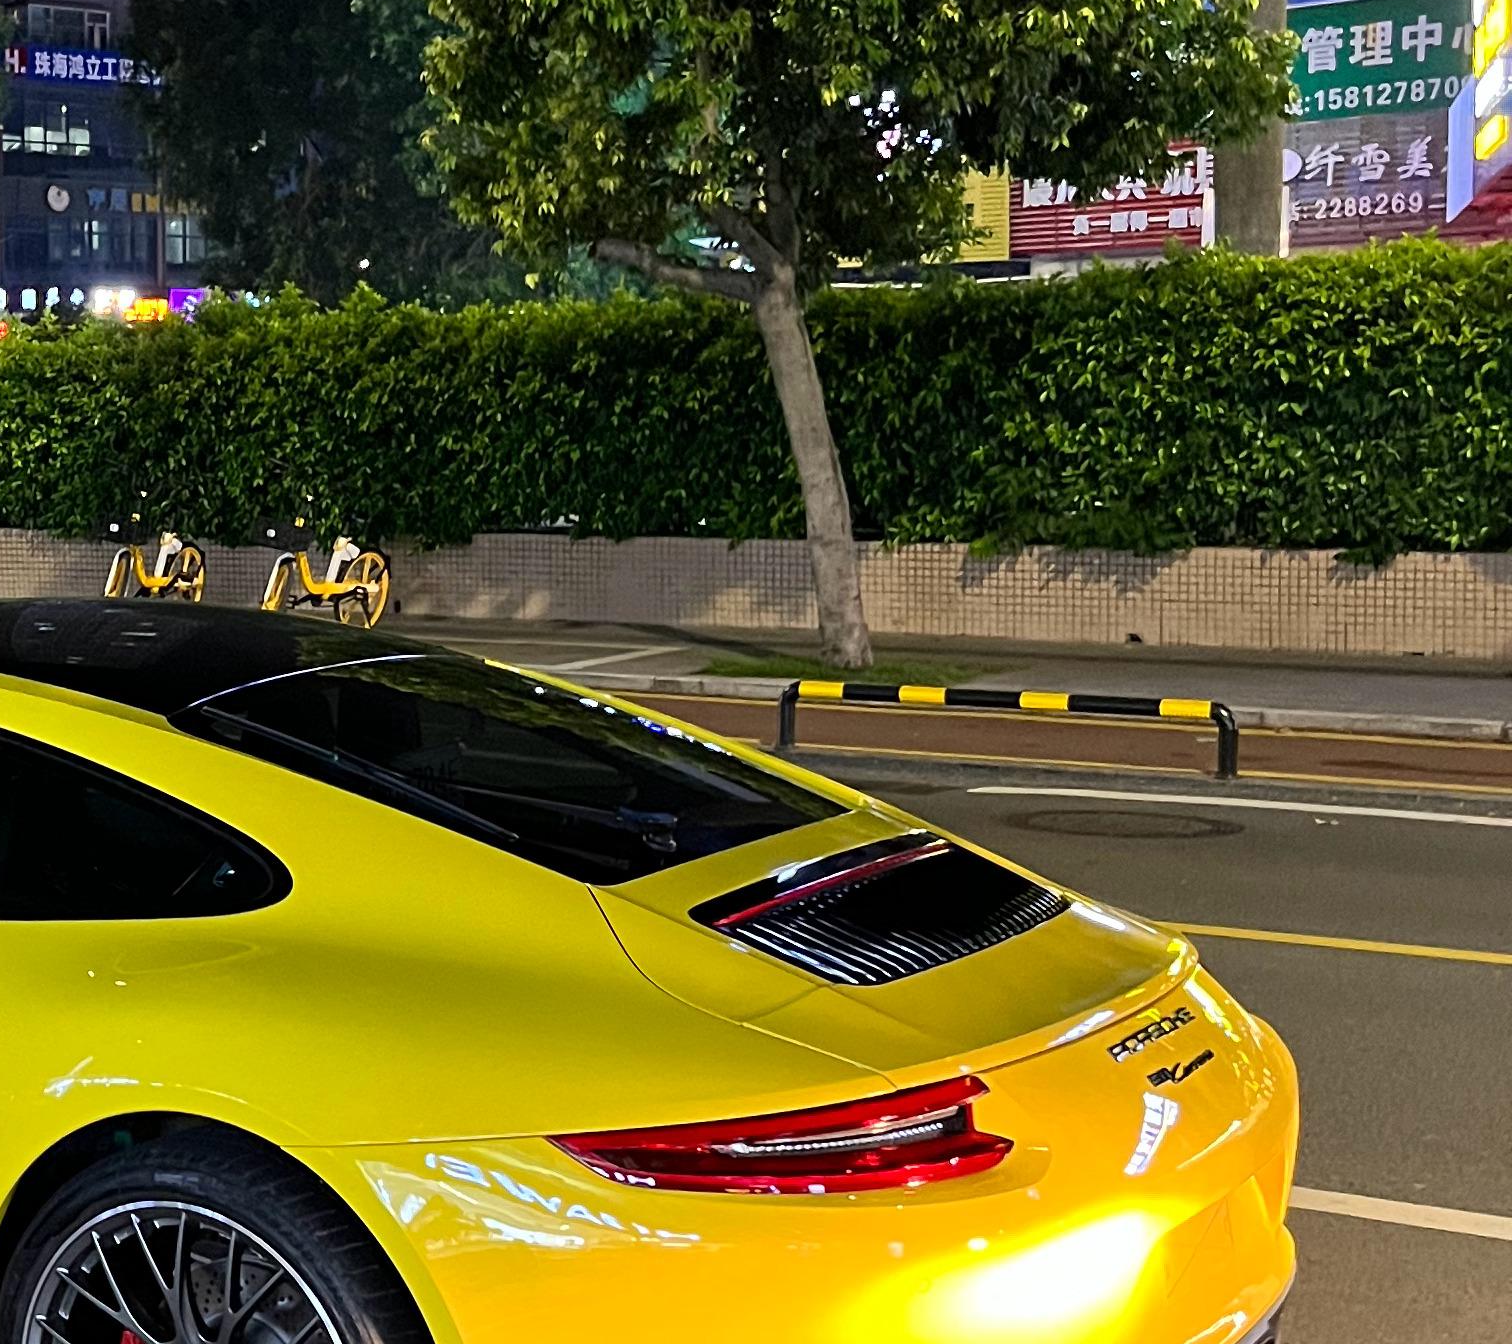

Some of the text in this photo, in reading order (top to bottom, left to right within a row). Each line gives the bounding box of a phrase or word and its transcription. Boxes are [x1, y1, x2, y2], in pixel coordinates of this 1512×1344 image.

[1285, 75, 1469, 115] :158127870
[1304, 136, 1448, 187] 纤雪美
